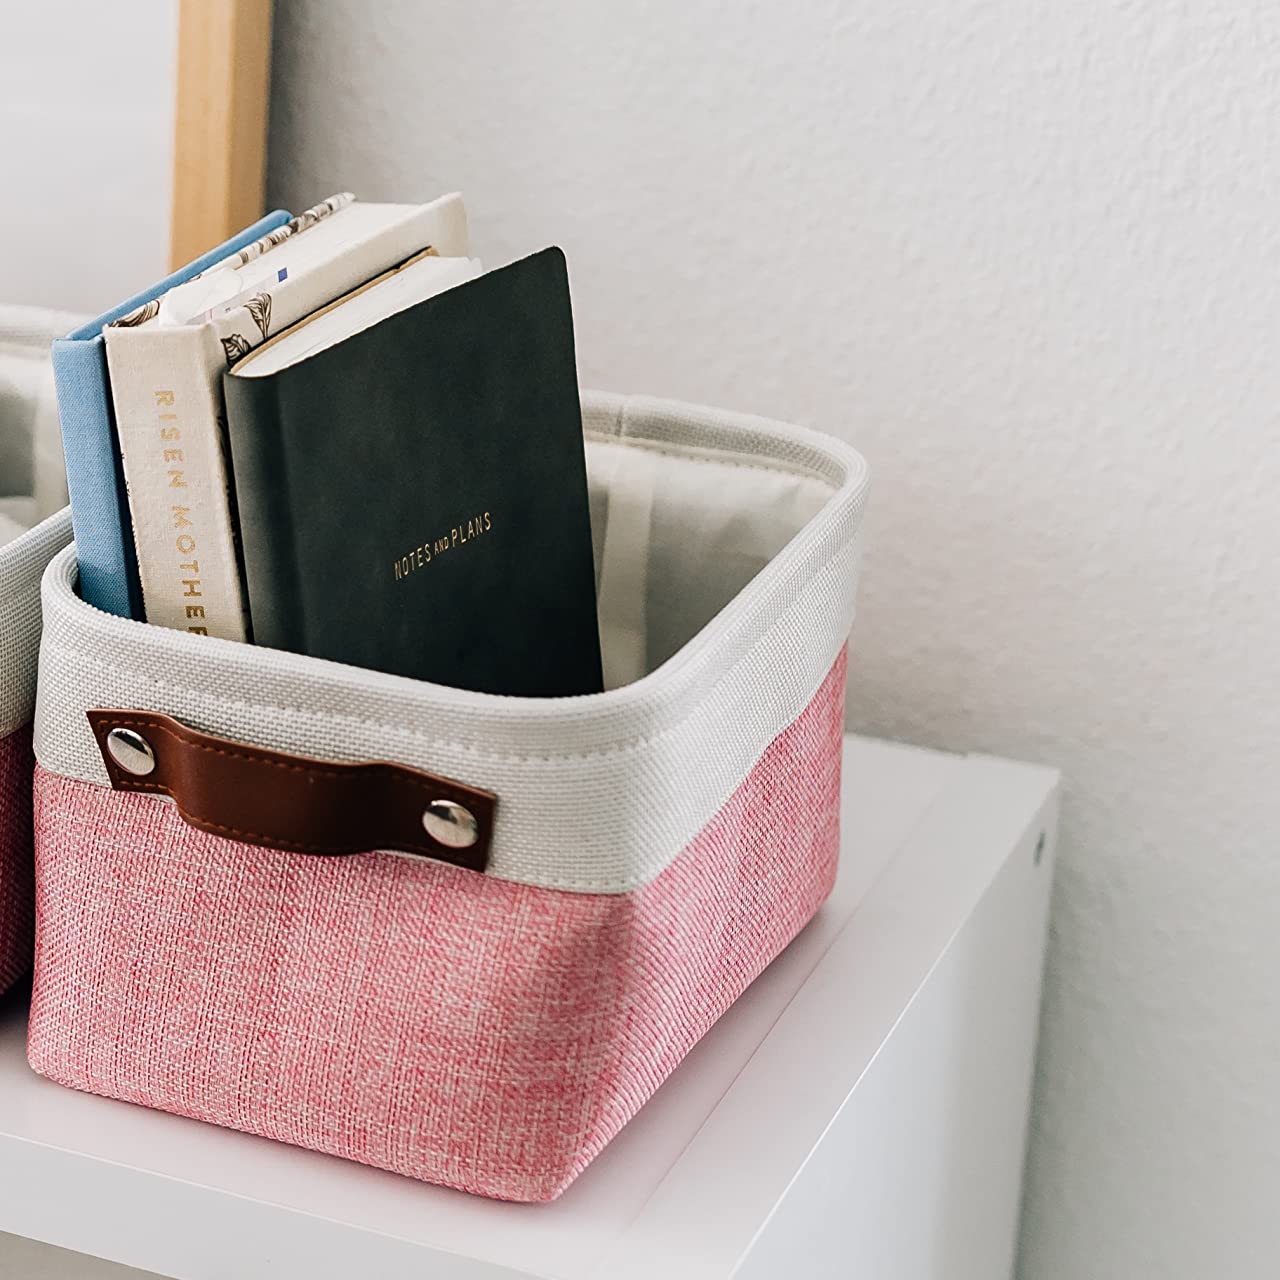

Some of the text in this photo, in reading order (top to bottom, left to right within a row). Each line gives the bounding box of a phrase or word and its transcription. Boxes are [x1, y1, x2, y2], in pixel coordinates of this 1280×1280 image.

[154, 390, 187, 489] RISEN
[394, 511, 491, 580] NOTES AND PLANS
